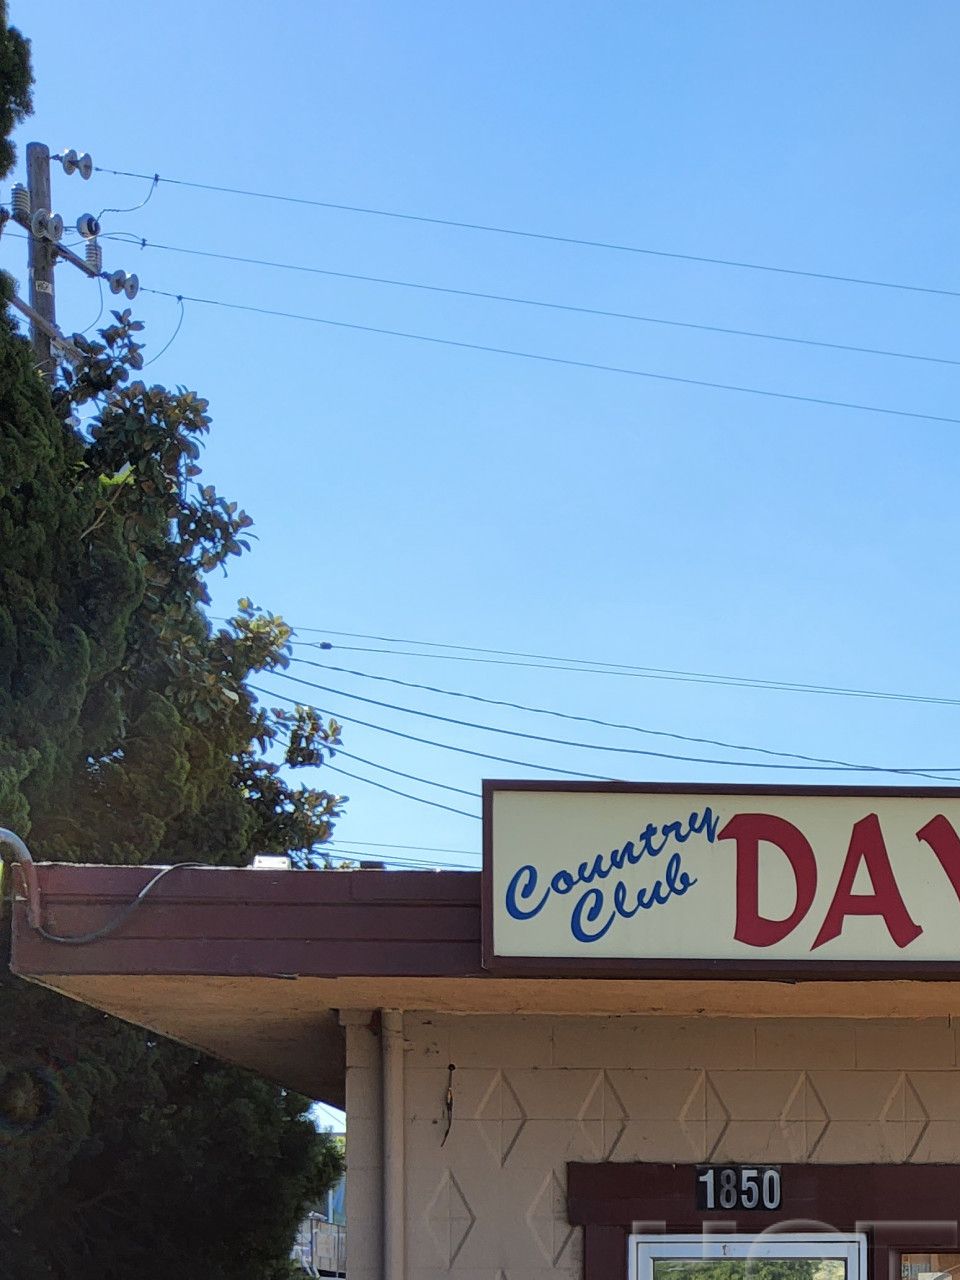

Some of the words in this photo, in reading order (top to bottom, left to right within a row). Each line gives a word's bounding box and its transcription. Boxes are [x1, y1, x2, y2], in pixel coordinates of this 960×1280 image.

[505, 807, 719, 920] Country
[570, 852, 698, 943] Club
[698, 1169, 781, 1210] 1850
